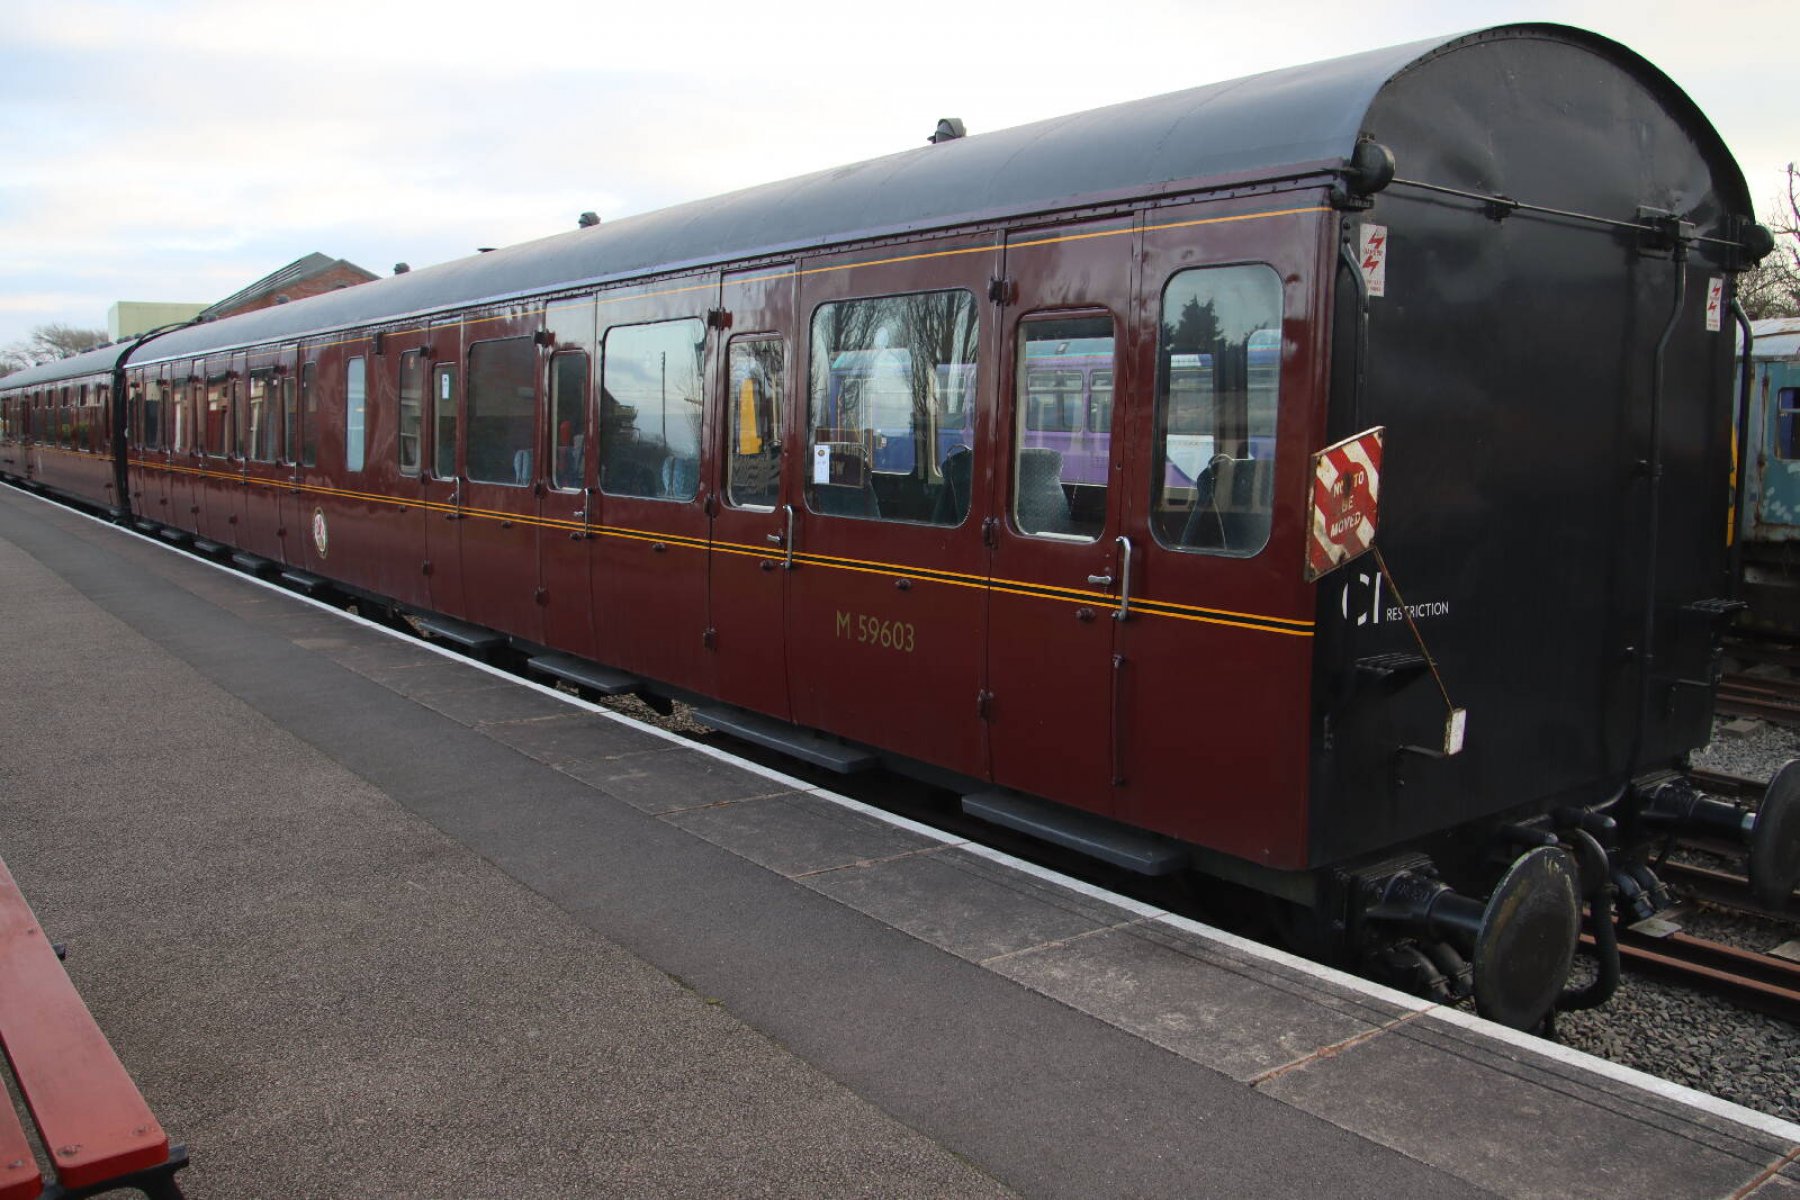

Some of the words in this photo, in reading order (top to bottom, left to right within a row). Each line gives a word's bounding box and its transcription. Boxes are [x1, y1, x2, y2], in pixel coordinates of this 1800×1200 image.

[1352, 470, 1365, 488] TO
[1341, 494, 1354, 513] BE
[1330, 511, 1361, 539] MOVED
[836, 609, 851, 640] M
[858, 614, 915, 652] 59603
